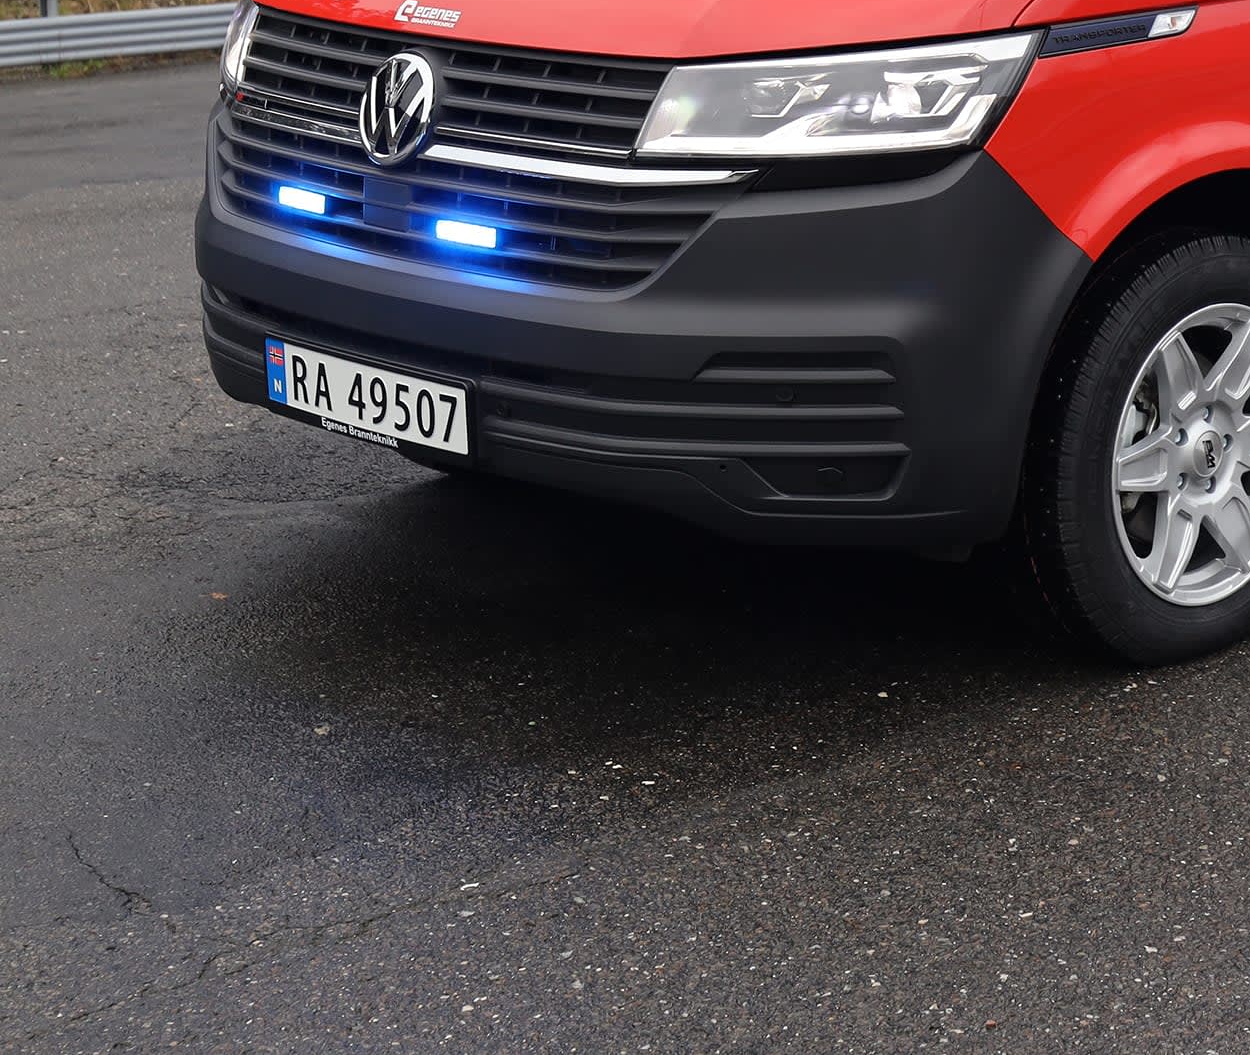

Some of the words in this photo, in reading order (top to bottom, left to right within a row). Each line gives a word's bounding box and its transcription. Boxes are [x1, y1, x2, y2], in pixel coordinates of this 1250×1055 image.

[1052, 24, 1148, 44] TRANSPORTER
[274, 378, 282, 393] N
[291, 354, 333, 412] RA
[348, 371, 458, 443] 49507
[321, 416, 348, 434] Egenes
[348, 424, 399, 448] Brannteknikk
